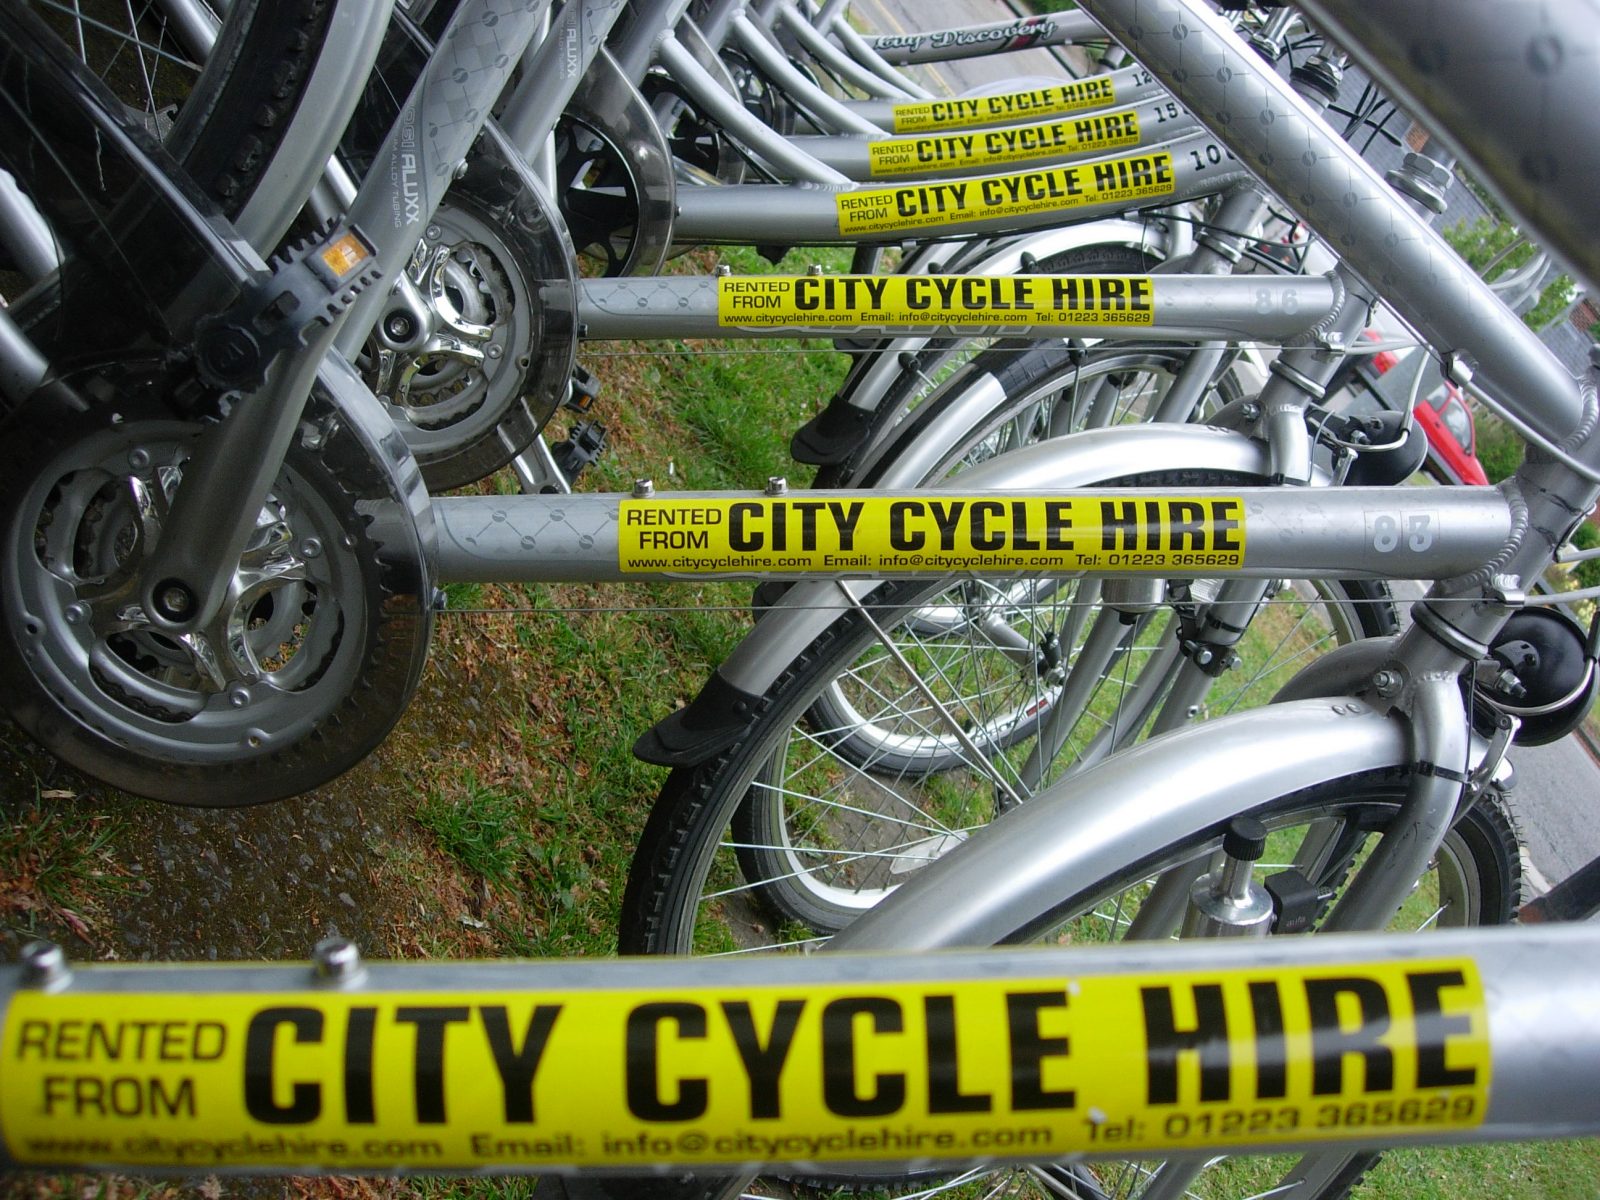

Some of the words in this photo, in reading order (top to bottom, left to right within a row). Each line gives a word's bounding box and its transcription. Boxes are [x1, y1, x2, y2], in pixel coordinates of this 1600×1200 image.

[931, 21, 1059, 48] Discovery
[566, 28, 577, 78] ALUXX
[896, 106, 930, 116] RENTED
[931, 99, 978, 121] CITY
[987, 89, 1054, 114] CYCLE
[1061, 79, 1113, 103] HIRE
[1154, 102, 1190, 123] 15
[901, 116, 928, 124] FROM
[872, 143, 914, 155] RENTED
[916, 136, 974, 162] CITY
[985, 124, 1066, 155] CYCLE
[1074, 113, 1137, 143] HIRE
[391, 153, 399, 189] ALLOY
[879, 154, 910, 165] FROM
[1190, 144, 1236, 171] 10
[402, 153, 420, 225] ALUXX
[896, 183, 967, 217] CITY
[981, 169, 1082, 206] CYCLE
[1093, 154, 1171, 192] HIRE
[392, 191, 402, 228] TUBING
[841, 195, 893, 210] RENTED
[844, 215, 944, 233] www.citycyclehire.com
[950, 211, 976, 221] Email:
[979, 197, 1079, 218] info@citycyclehire.com
[1085, 194, 1098, 203] Tel:
[1102, 189, 1133, 200] 01223
[1135, 184, 1172, 196] 365629
[850, 208, 888, 222] FROM
[724, 281, 790, 293] RENTED
[794, 278, 889, 311] CITY
[905, 278, 1035, 311] CYCLE
[1051, 278, 1150, 311] HIRE
[1255, 287, 1299, 315] 86
[732, 295, 781, 309] FROM
[724, 312, 853, 324] www.citycyclehire.com
[860, 312, 895, 322] Email:
[899, 312, 1028, 324] info@citycyclehire.com
[1035, 312, 1054, 322] Tel:
[1058, 312, 1099, 323] 01223
[1102, 312, 1150, 323] 365629
[626, 508, 722, 526] RENTED
[728, 501, 864, 552] CITY
[890, 501, 1074, 552] CYCLE
[1100, 501, 1240, 551] HIRE
[639, 530, 708, 550] FROM
[1373, 515, 1433, 553] 83
[628, 555, 812, 570] www.citycyclehire.com
[824, 555, 872, 567] Email:
[879, 554, 1063, 569] info@citycyclehire.com
[1075, 554, 1101, 566] Tel:
[1108, 554, 1165, 566] 01223
[1171, 554, 1239, 566] 365629
[16, 1019, 228, 1063] RENTED
[243, 1004, 563, 1125] CITY
[624, 990, 1076, 1123] CYCLE
[1139, 969, 1476, 1106] HIRE
[43, 1074, 197, 1119] FROM
[470, 1133, 586, 1158] Email:
[603, 1124, 1053, 1161] info@citycyclehire.com
[1083, 1118, 1145, 1144] Tel:
[1163, 1109, 1300, 1139] 01223
[1316, 1096, 1478, 1130] 365629
